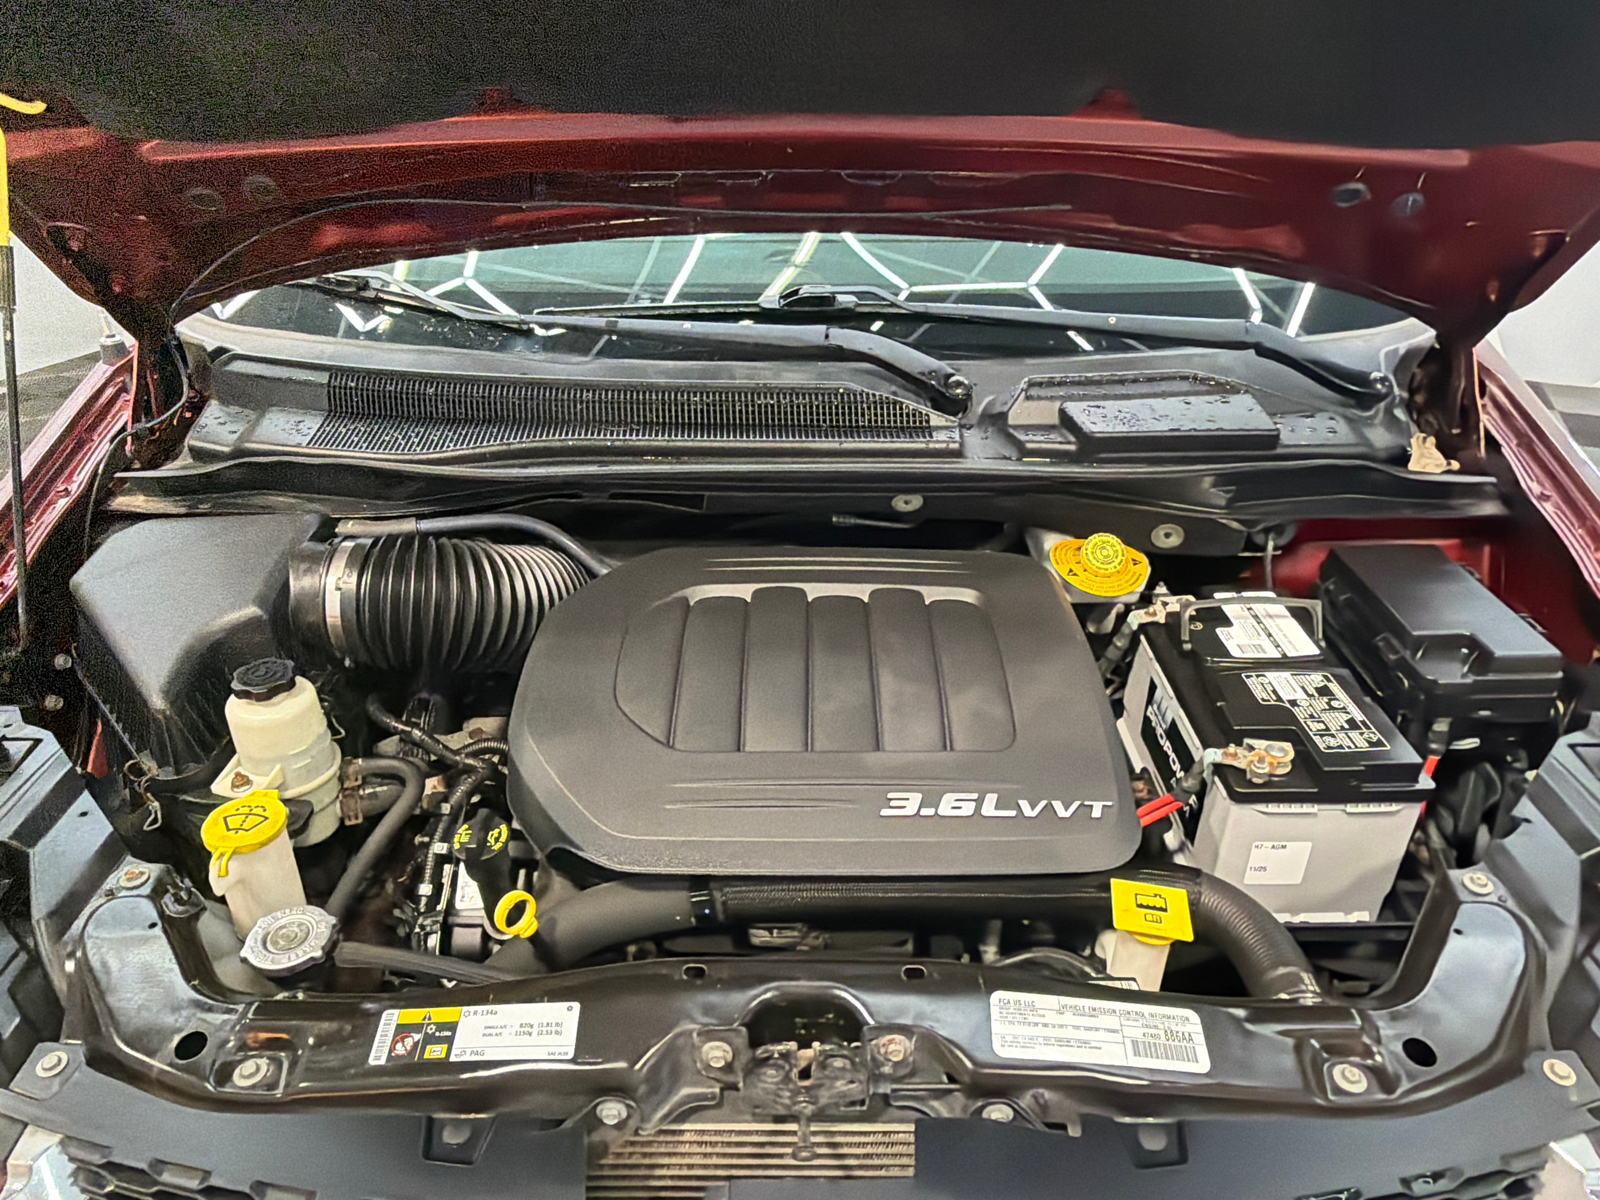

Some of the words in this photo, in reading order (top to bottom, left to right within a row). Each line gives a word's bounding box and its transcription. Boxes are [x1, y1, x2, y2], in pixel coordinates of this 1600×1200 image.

[1088, 1006, 1117, 1014] EMISSION
[1119, 1009, 1146, 1018] CONTROL
[1148, 1012, 1190, 1022] INFORMATION
[1164, 1030, 1194, 1044] 886AA
